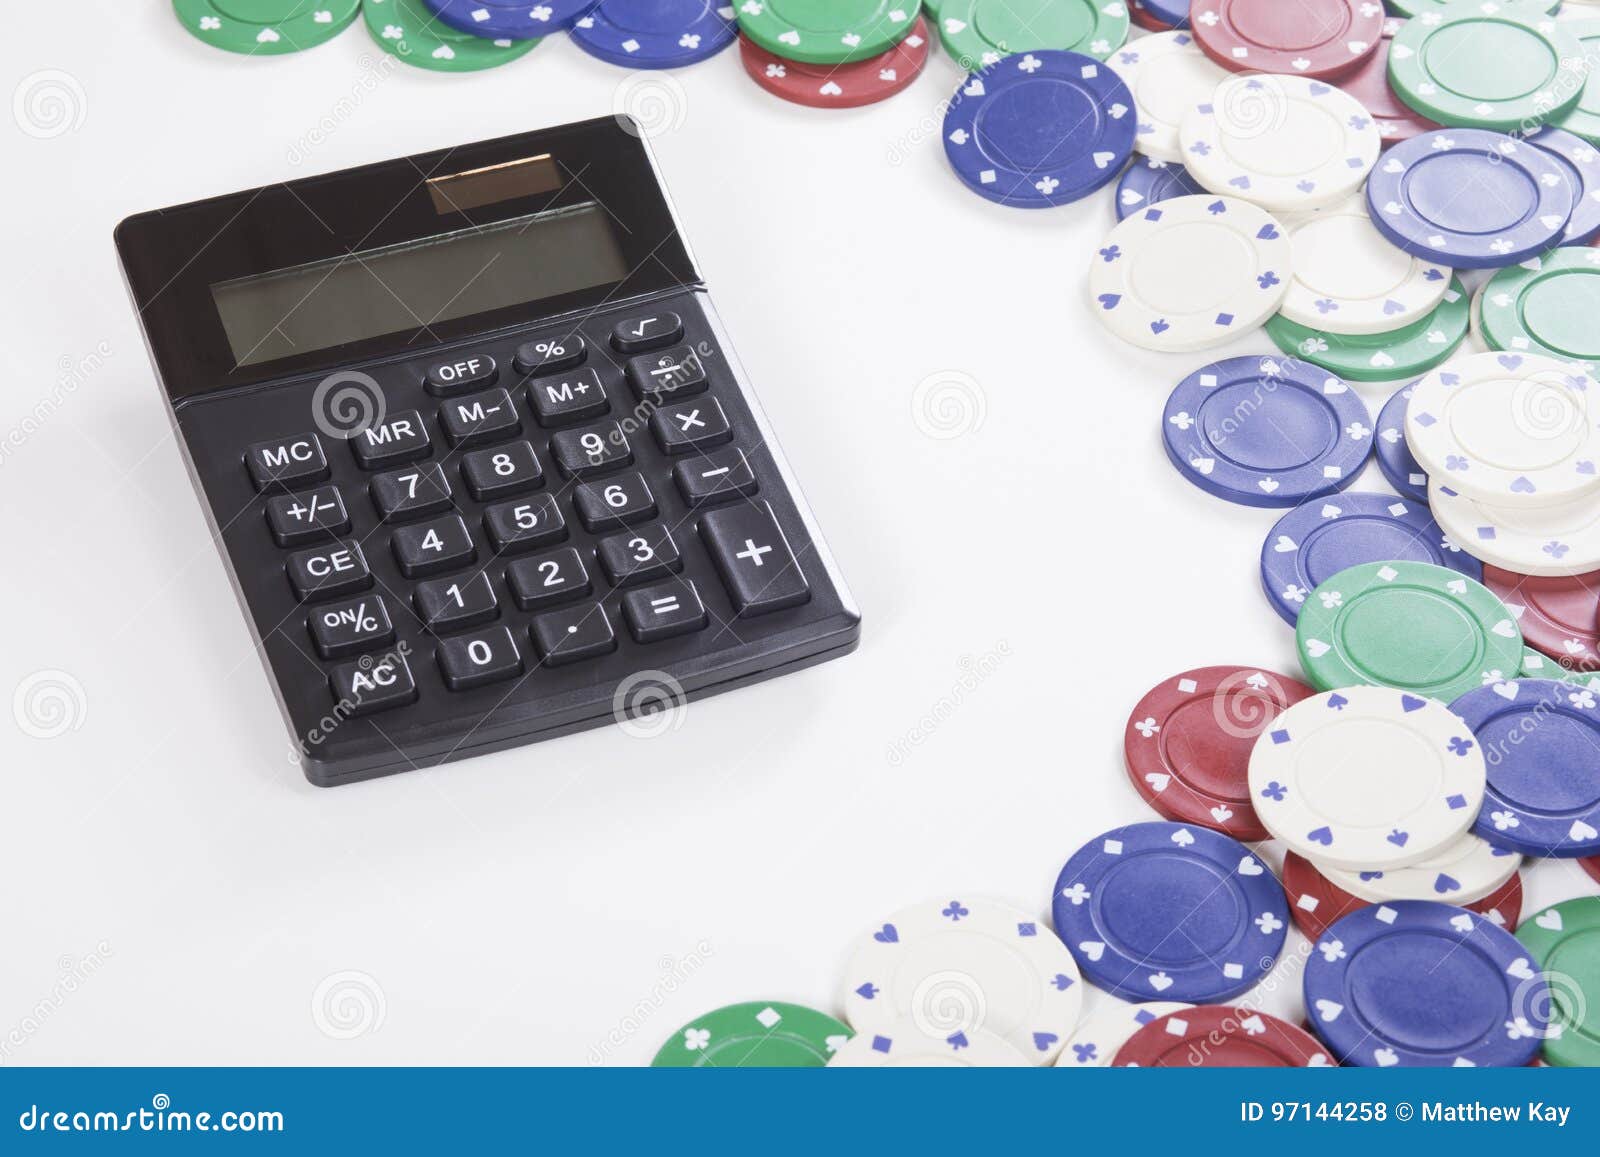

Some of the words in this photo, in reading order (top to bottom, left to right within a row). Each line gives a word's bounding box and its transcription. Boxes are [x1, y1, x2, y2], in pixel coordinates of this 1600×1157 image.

[535, 341, 566, 359] %
[439, 359, 481, 381] OFF
[546, 382, 591, 403] M+
[457, 402, 501, 423] M-
[364, 420, 416, 446] MR
[580, 433, 604, 456] 9
[262, 441, 314, 467] MC
[492, 453, 516, 476] 8
[397, 473, 420, 500] 7
[604, 485, 628, 508] 6
[286, 494, 336, 524] +/-
[514, 505, 538, 530] 5
[421, 529, 444, 553] 4
[629, 537, 655, 562] 3
[306, 549, 355, 577] CE
[538, 561, 565, 587] 2
[446, 583, 464, 609] 1
[323, 603, 378, 633] ON/C
[467, 640, 493, 665] 0
[351, 664, 398, 694] AC
